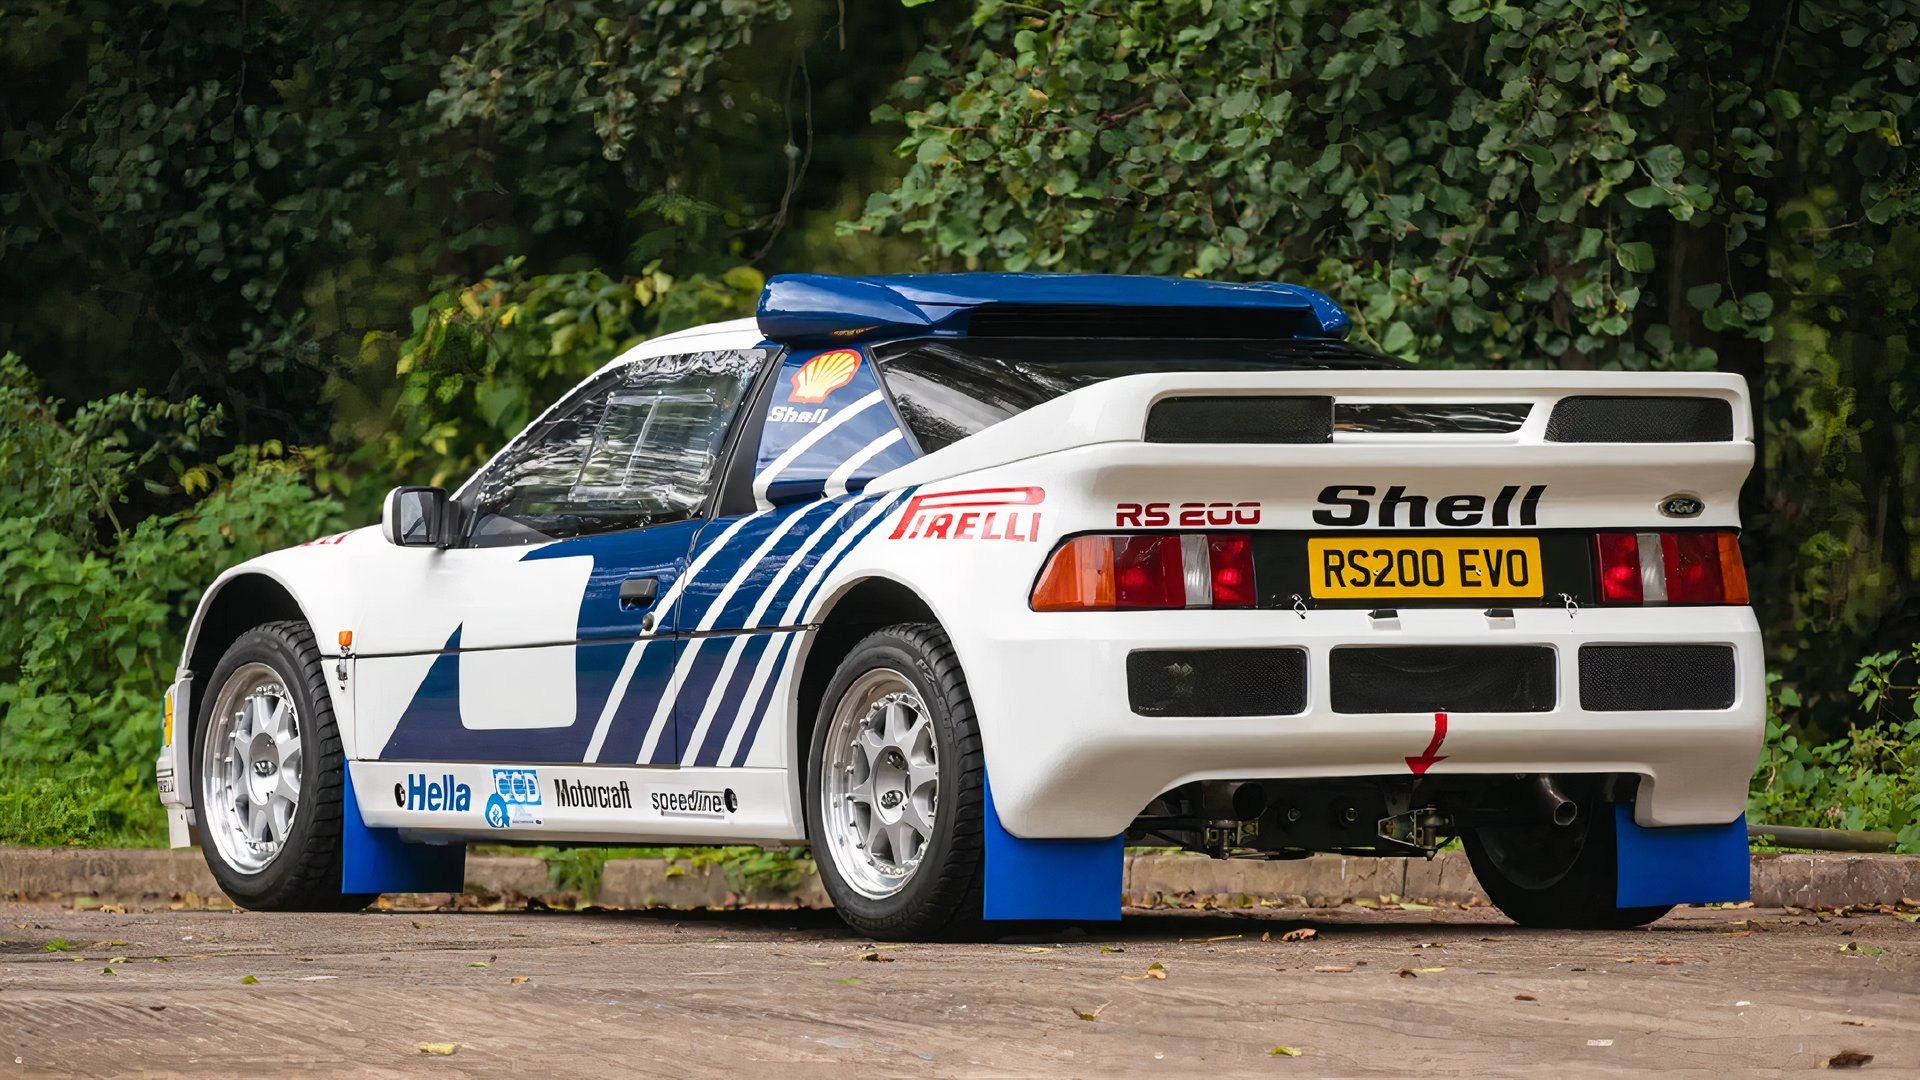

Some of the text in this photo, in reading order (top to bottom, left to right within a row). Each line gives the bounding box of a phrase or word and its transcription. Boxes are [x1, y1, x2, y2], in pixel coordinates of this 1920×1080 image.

[767, 406, 828, 424] Shell
[887, 486, 1045, 542] PIRELLI
[1116, 502, 1260, 526] RS 200
[1312, 485, 1547, 527] Shell
[1323, 549, 1528, 588] RS200 EVO
[407, 773, 471, 811] Hella
[553, 779, 632, 809] Motorcraft
[651, 790, 722, 813] speedline
